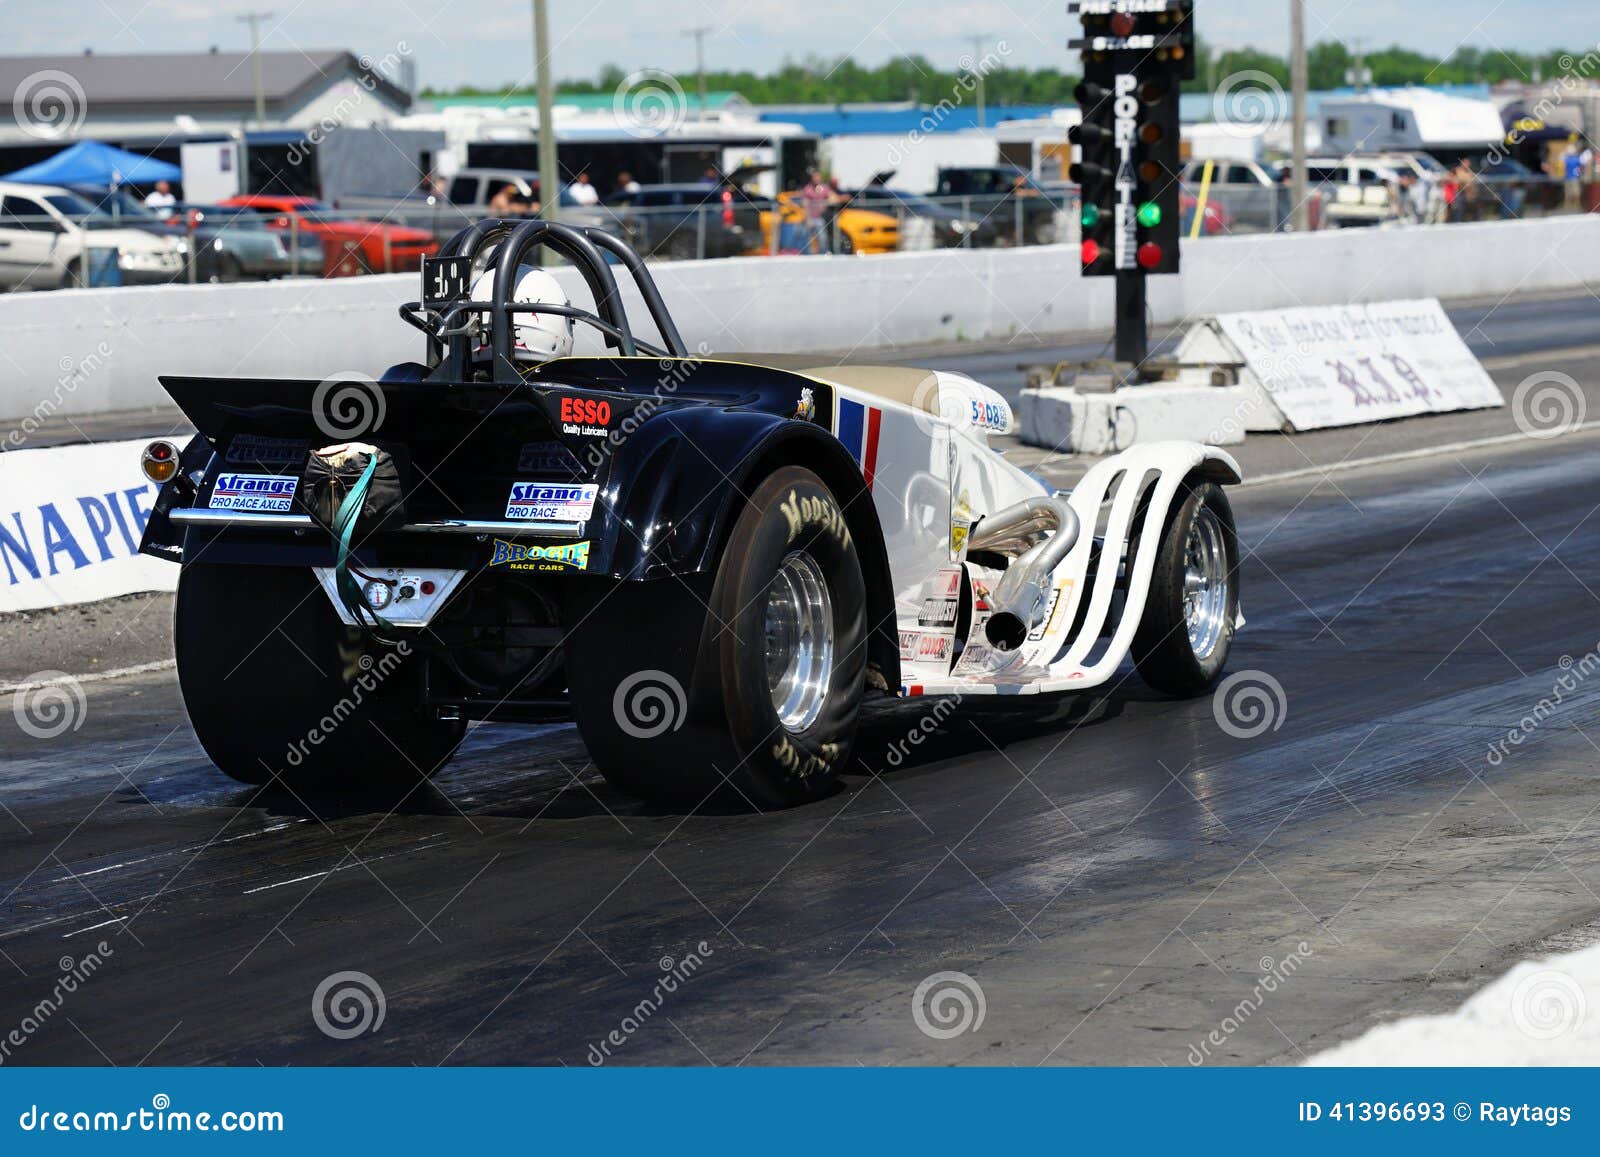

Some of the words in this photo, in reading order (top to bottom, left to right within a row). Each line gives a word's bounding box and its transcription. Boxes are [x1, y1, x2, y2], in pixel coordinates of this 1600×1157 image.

[560, 397, 611, 426] ESSO
[971, 399, 1000, 426] 5208
[563, 422, 581, 437] Quality
[581, 425, 608, 438] Lubricants
[217, 474, 296, 494] Strange
[511, 483, 594, 502] Strange
[211, 497, 232, 507] PRO
[232, 498, 260, 509] RACE
[260, 500, 292, 510] AXLES
[506, 507, 529, 518] PRO
[529, 507, 558, 518] RACE
[0, 484, 160, 586] NAPIE
[489, 537, 591, 571] BROGIE
